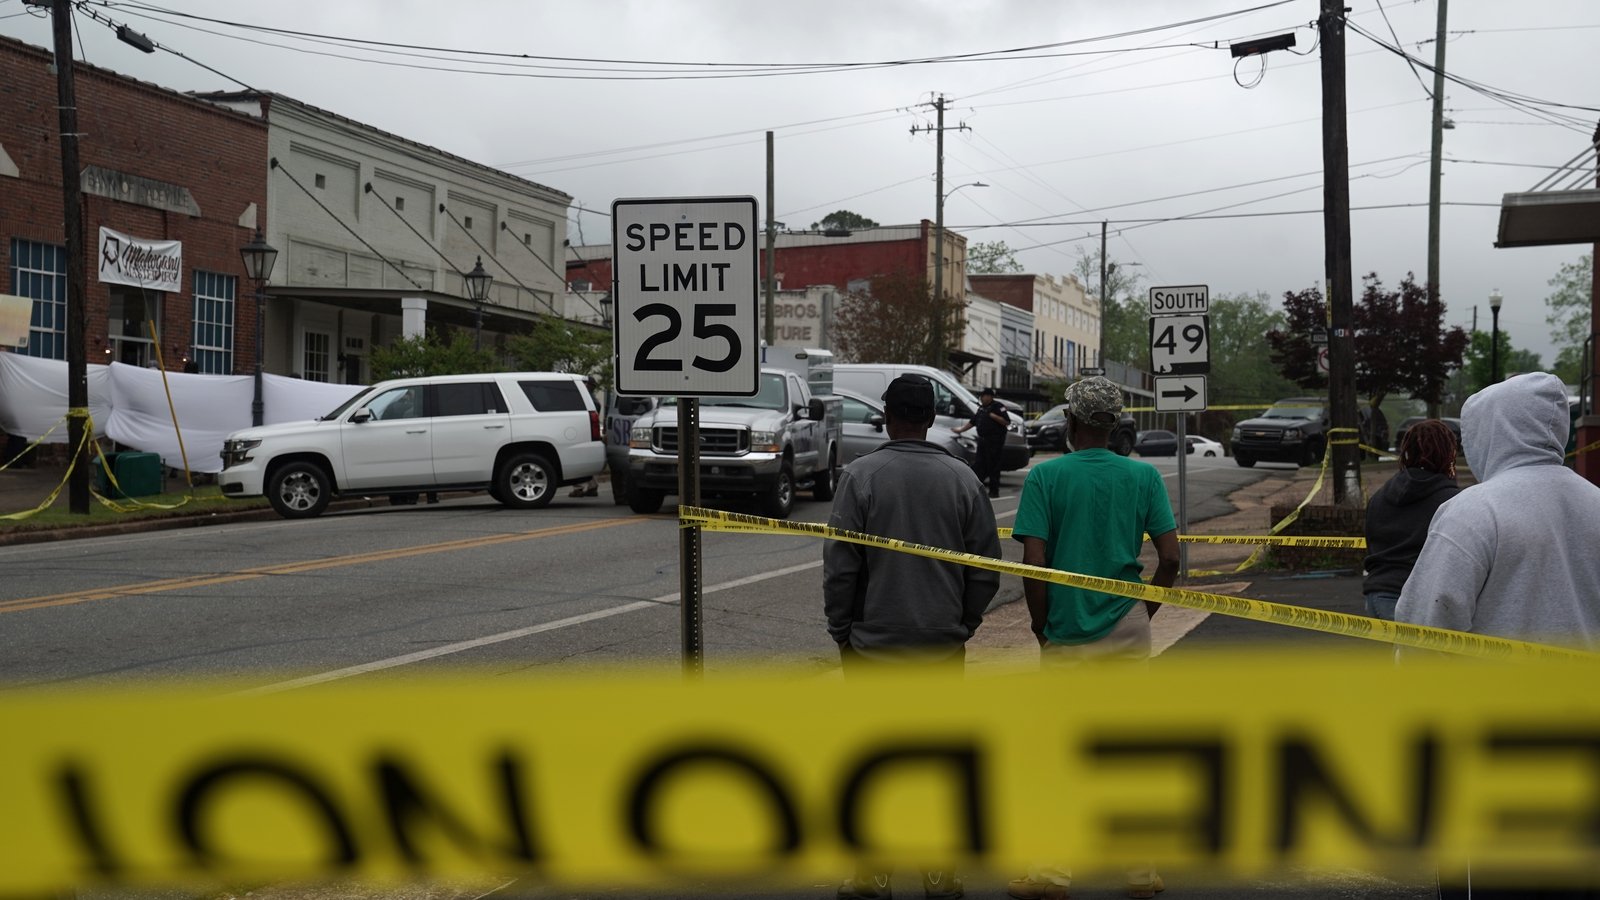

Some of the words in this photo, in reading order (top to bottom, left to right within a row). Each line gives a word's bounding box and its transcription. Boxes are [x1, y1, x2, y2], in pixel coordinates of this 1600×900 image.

[626, 223, 745, 251] SPEED
[640, 263, 730, 291] LIMIT
[1154, 292, 1205, 309] SOUTH
[633, 303, 741, 372] 25
[1153, 324, 1204, 355] 49
